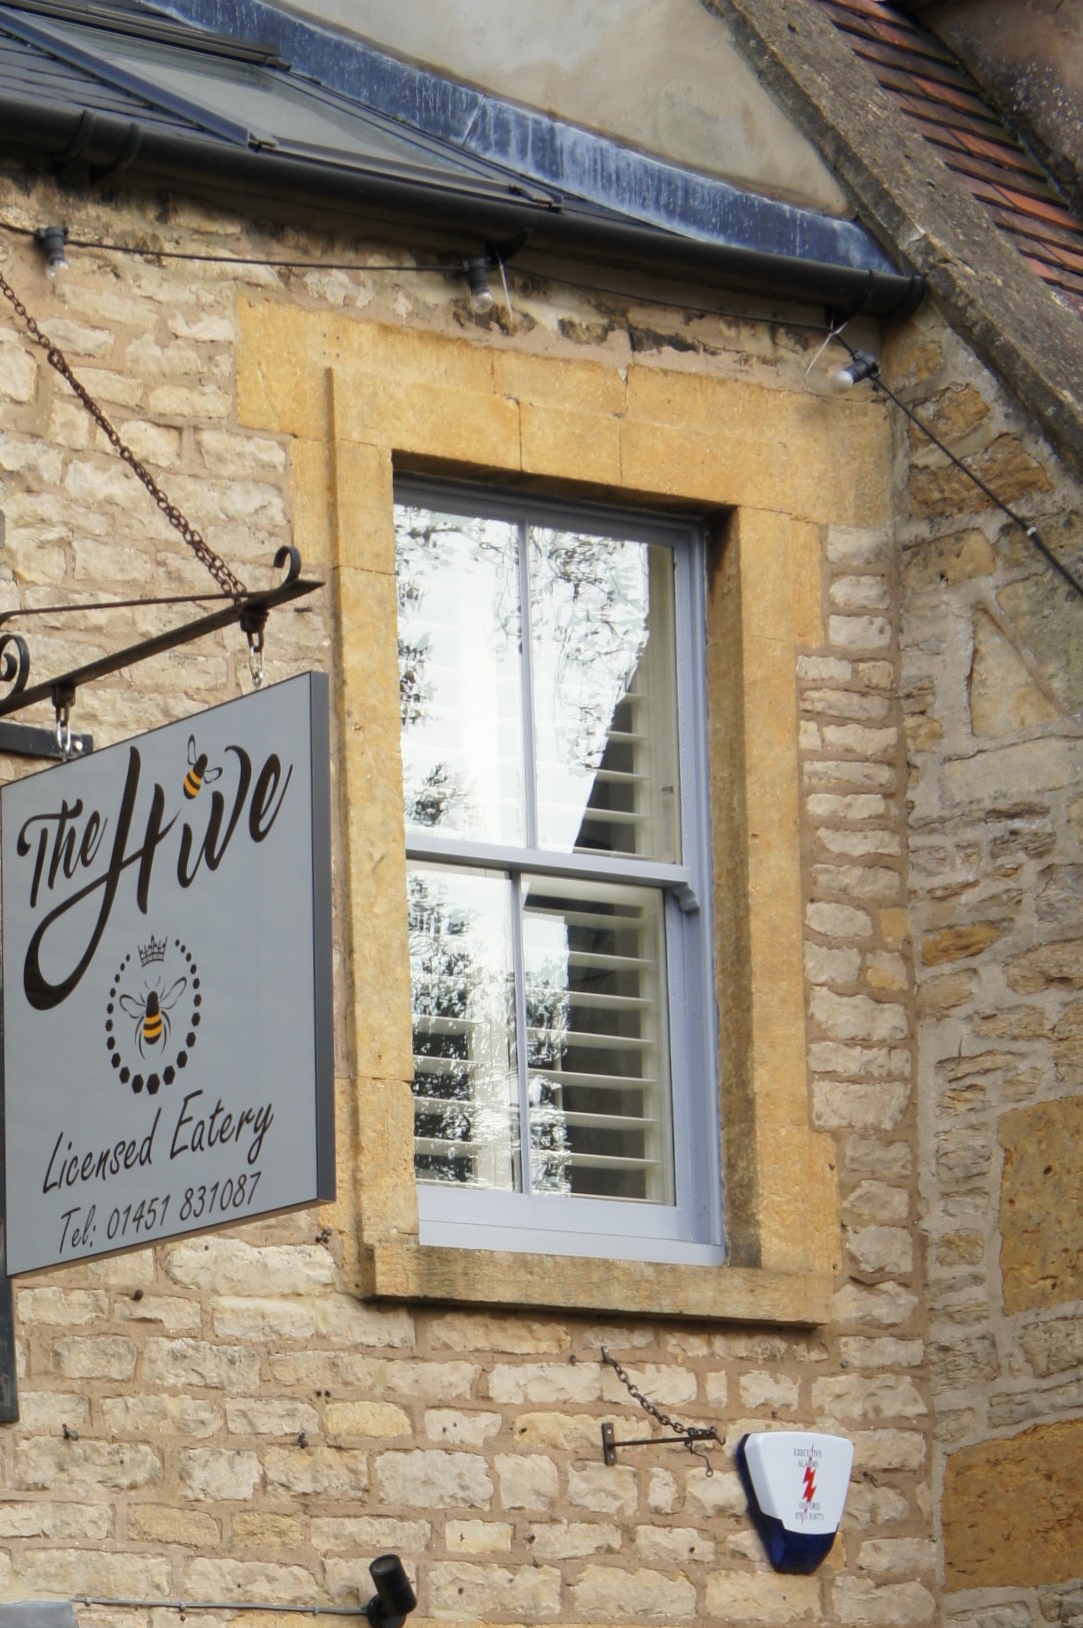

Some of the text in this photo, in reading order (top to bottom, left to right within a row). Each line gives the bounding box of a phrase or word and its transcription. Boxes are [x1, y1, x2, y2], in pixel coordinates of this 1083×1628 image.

[17, 744, 293, 1011] The Hive
[42, 1089, 275, 1195] Licensed Eatery
[57, 1171, 262, 1255] Tel: 01451 831087
